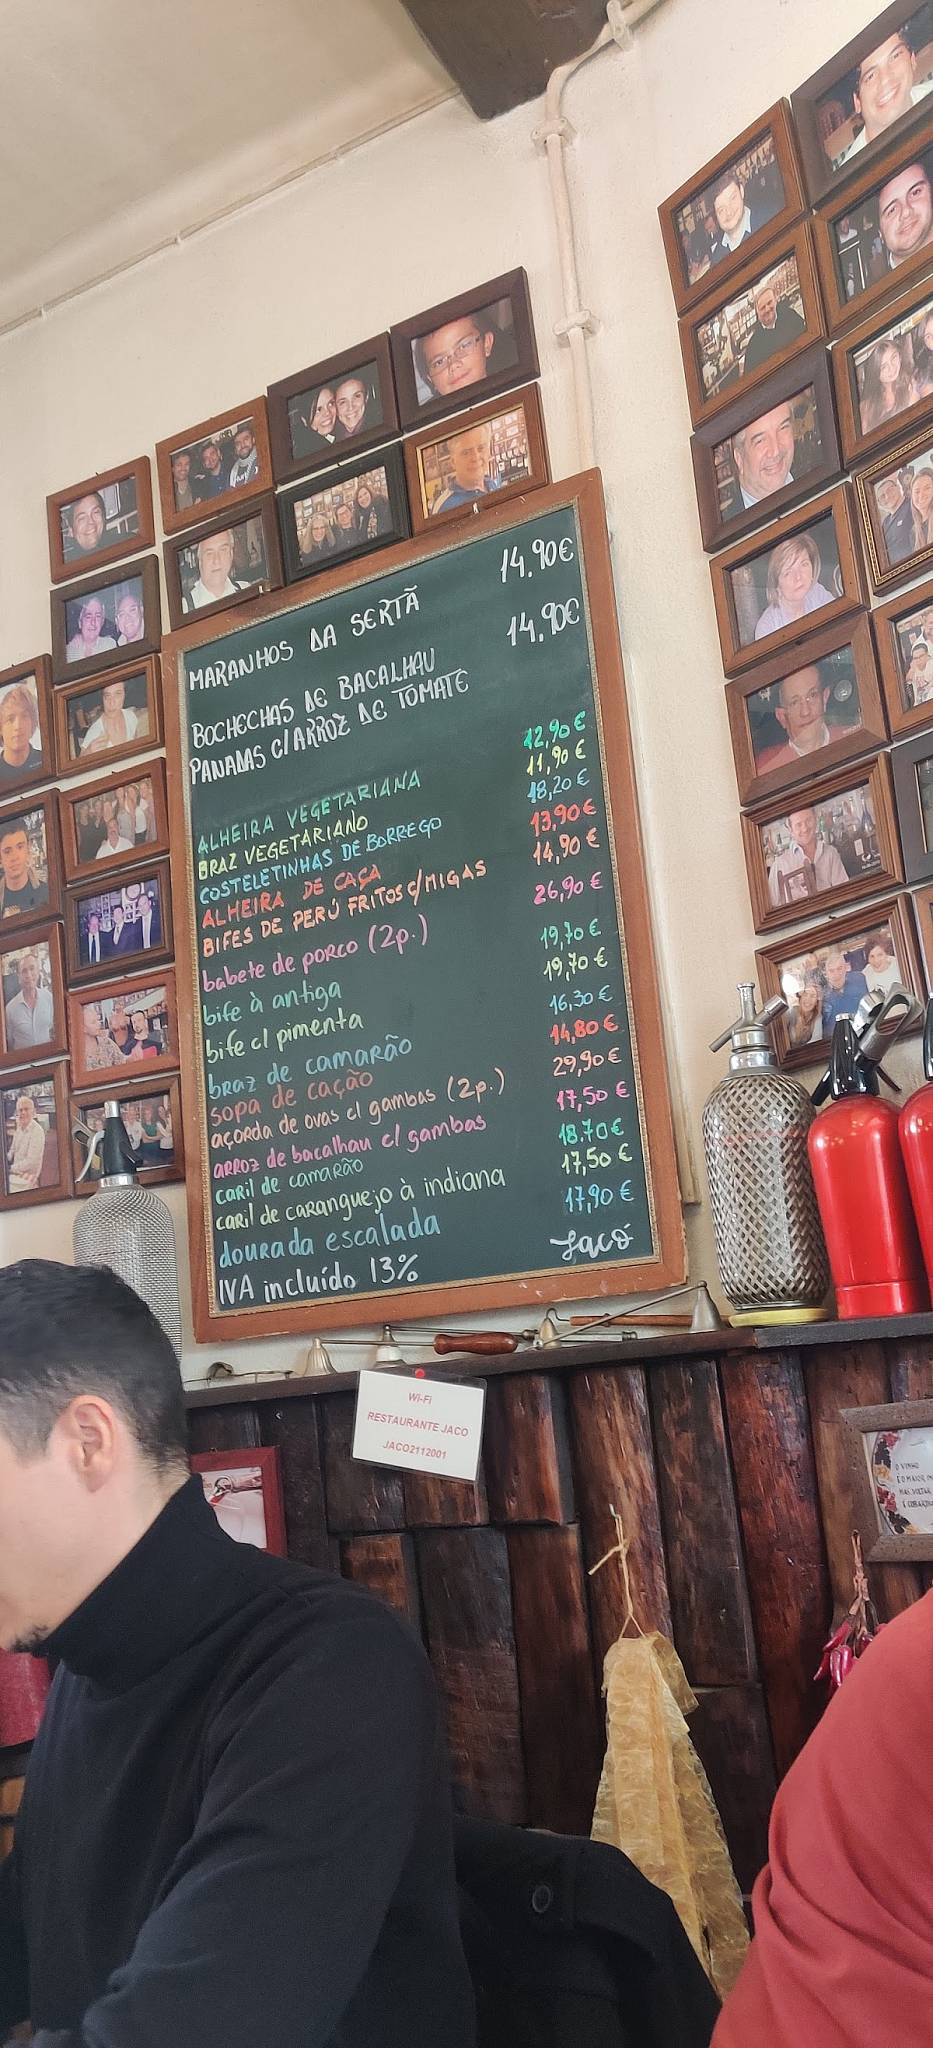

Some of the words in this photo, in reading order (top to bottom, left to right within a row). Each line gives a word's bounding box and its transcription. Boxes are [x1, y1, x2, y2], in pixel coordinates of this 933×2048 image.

[189, 640, 294, 691] MARANHOS
[310, 624, 337, 652] DA
[350, 585, 420, 637] SERTÃ
[189, 745, 266, 785] PANADAS
[358, 700, 388, 726] DE
[391, 668, 469, 709] TOMATE
[191, 697, 295, 749] BOCHECHAS
[305, 687, 328, 713] DE
[338, 647, 435, 700] BACALHAU
[198, 815, 274, 854] ALHEIRA
[287, 769, 421, 829] VEGETARIANA
[198, 853, 237, 881] BRAZ
[244, 809, 368, 865] VEGETARIANO
[200, 849, 333, 905] COSTELETINHAS
[342, 839, 361, 862] DE
[366, 817, 442, 851] BORREGO
[202, 891, 285, 929] ALHEIRA
[302, 879, 325, 900] DE
[333, 864, 382, 891] CAÇA
[202, 927, 254, 958] BIFES
[261, 917, 283, 938] DE
[348, 884, 403, 917] FRITOS
[202, 958, 266, 993] babete
[272, 952, 296, 976] de
[202, 1000, 242, 1026] bife
[250, 991, 264, 1014] à
[272, 979, 342, 1012] antiga
[206, 1029, 245, 1064] bife
[276, 1007, 365, 1052] pimenta
[267, 1063, 292, 1086] de
[305, 1034, 413, 1075] camarão
[210, 1097, 261, 1127] sopa
[272, 1083, 297, 1110] de
[307, 1069, 373, 1101] cação
[279, 1114, 299, 1135] de
[304, 1109, 340, 1131] ovas
[369, 1087, 437, 1125] gambas
[266, 1149, 287, 1169] de
[292, 1134, 373, 1164] bacalhau
[407, 1113, 488, 1153] gambas
[260, 1204, 281, 1226] de
[285, 1186, 393, 1221] caranguejo
[400, 1177, 415, 1201] à
[423, 1165, 506, 1197] indiana
[261, 1175, 281, 1196] de
[288, 1157, 364, 1189] camarão
[219, 1226, 314, 1269] dourada
[325, 1206, 441, 1252] escalada
[219, 1274, 255, 1306] IVA
[264, 1261, 357, 1303] incluído
[370, 1253, 420, 1284] 13%
[367, 1411, 440, 1432] RESTAURANTE
[440, 1424, 469, 1437] JACO
[383, 1440, 447, 1459] JACO2112001
